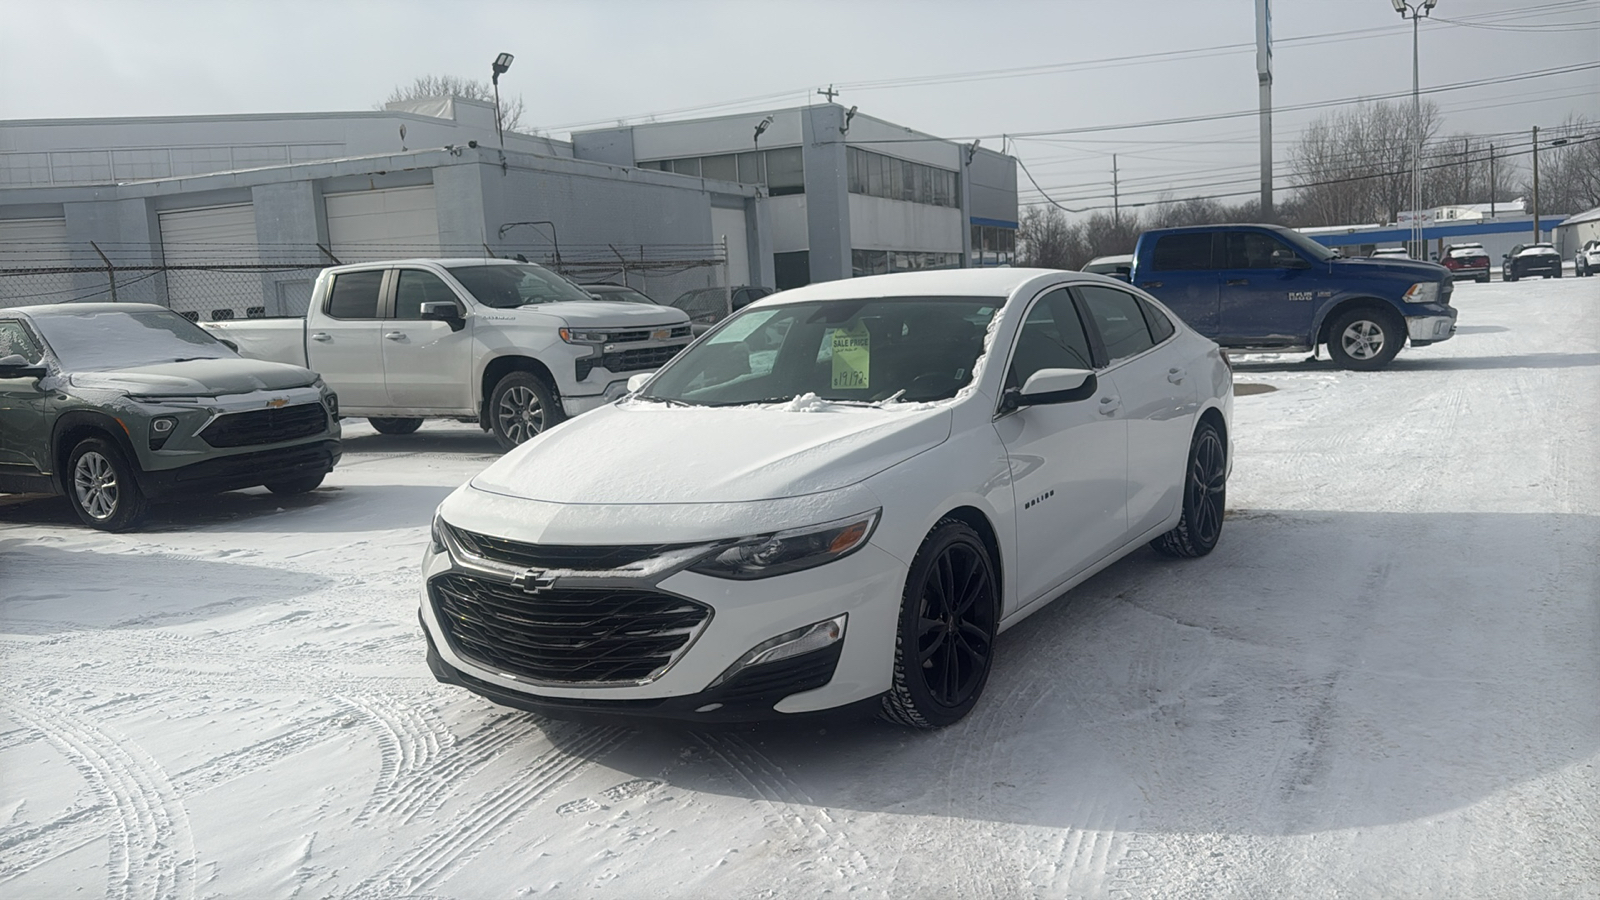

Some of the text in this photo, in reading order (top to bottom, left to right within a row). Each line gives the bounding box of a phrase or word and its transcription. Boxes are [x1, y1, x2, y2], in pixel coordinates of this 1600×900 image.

[833, 338, 869, 348] SALE PRICE
[1024, 489, 1055, 510] MALIBU
